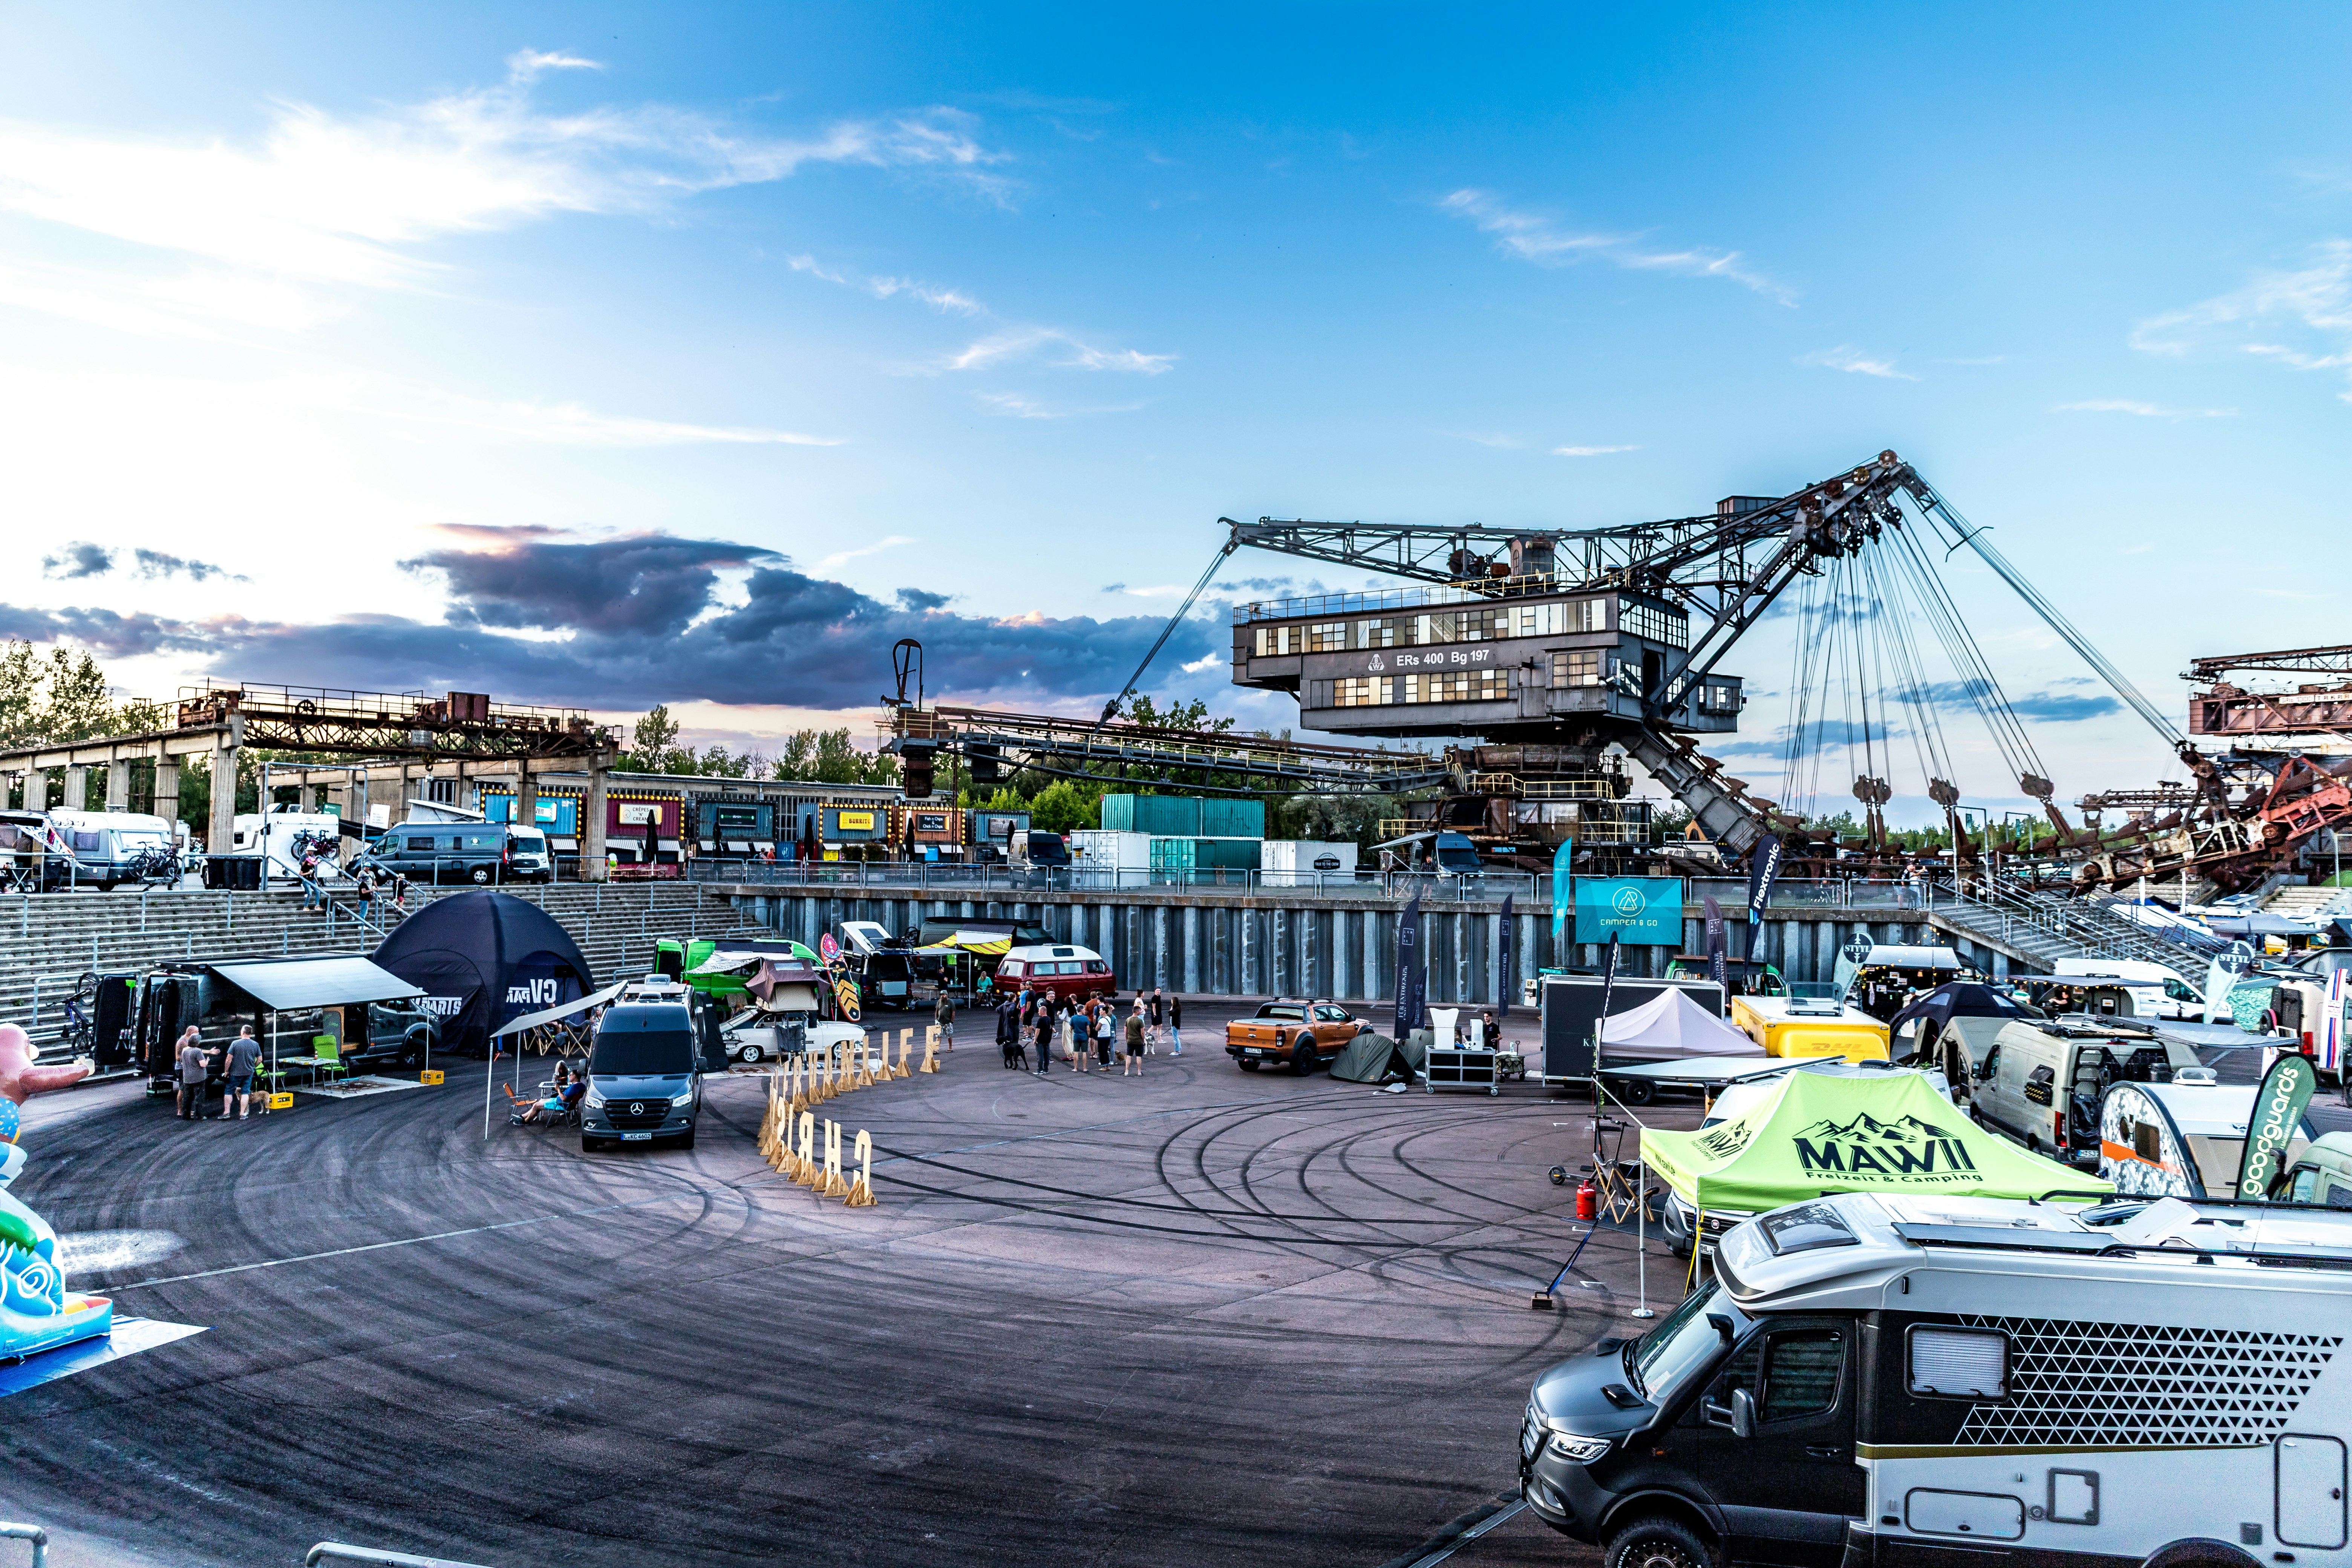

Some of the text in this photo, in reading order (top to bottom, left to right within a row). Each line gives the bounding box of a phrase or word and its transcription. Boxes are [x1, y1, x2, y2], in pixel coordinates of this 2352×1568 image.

[1396, 649, 1489, 666] ERs 400 Bg 197
[1753, 843, 1779, 909] Flextronic
[2219, 953, 2250, 964] STYYL
[1810, 1043, 1863, 1052] DHL
[2243, 1067, 2298, 1196] goodguards
[1699, 1130, 1743, 1158] MAWII
[1792, 1138, 1976, 1173] MAWII
[1805, 1171, 1876, 1182] Freizeit
[1901, 1173, 1984, 1183] Camping
